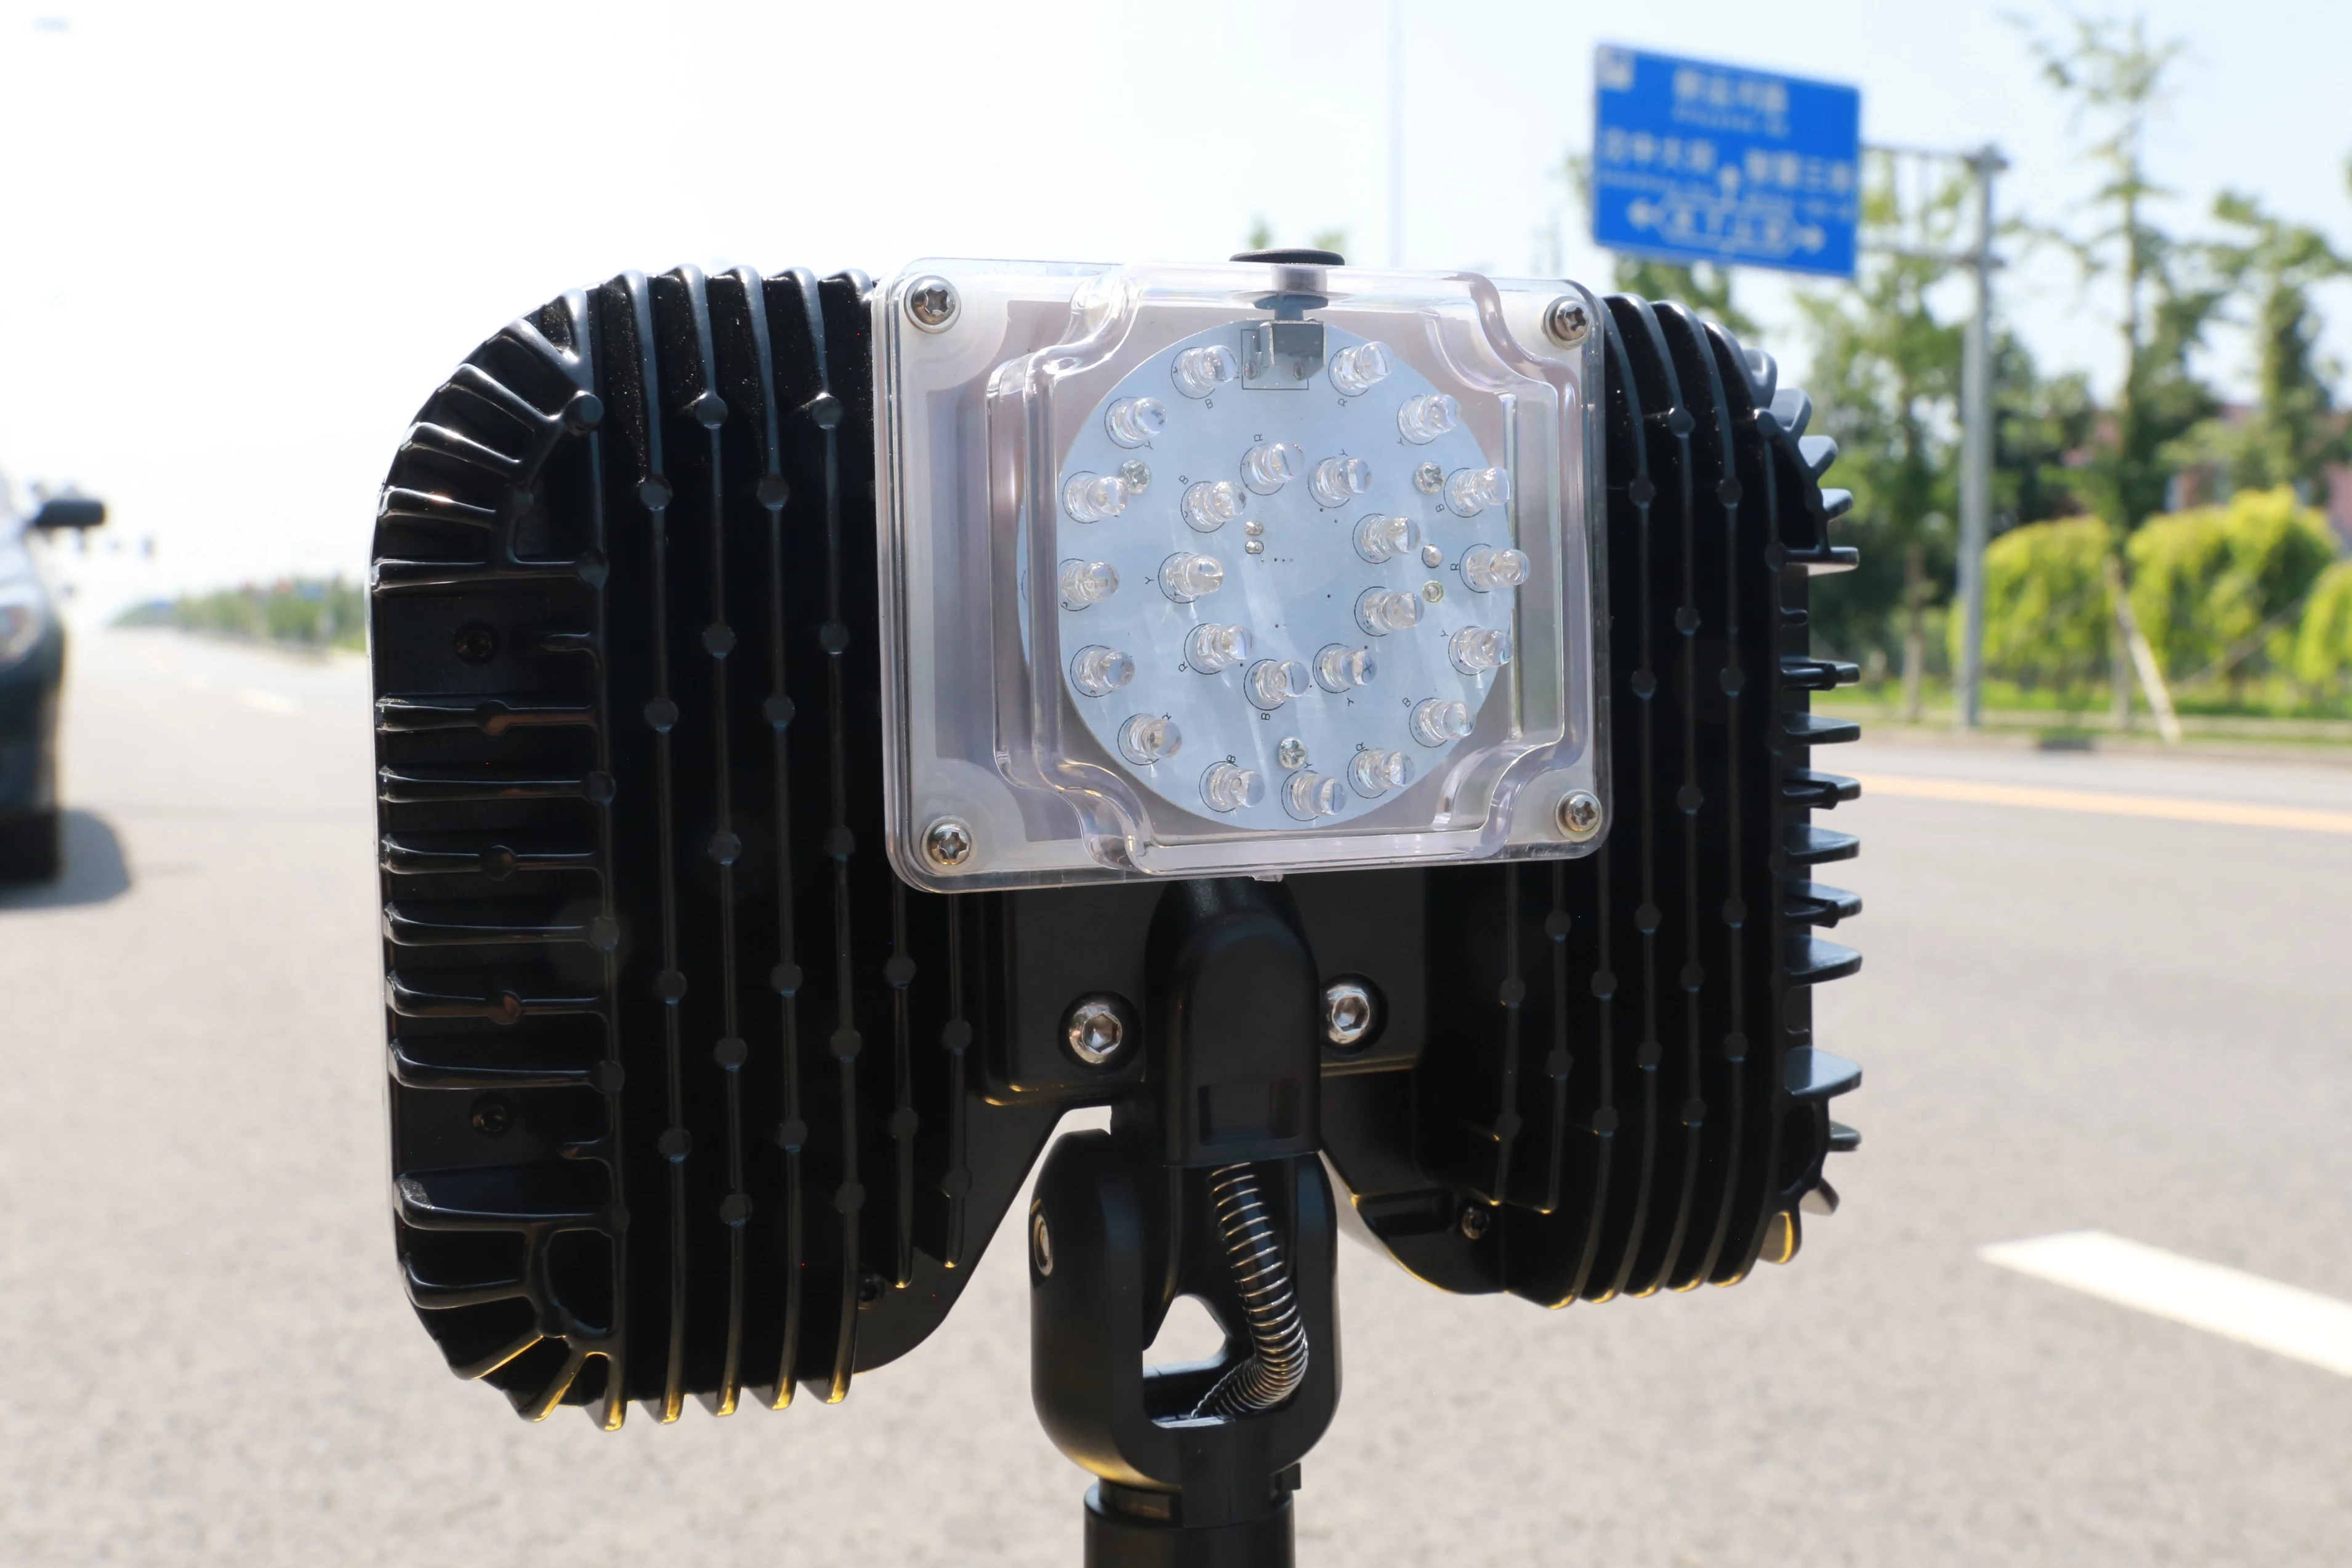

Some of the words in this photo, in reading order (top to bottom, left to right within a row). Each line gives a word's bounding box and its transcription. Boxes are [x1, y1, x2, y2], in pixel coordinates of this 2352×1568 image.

[1205, 398, 1213, 409] B
[1338, 398, 1348, 407] R
[1254, 433, 1263, 442] R
[1396, 438, 1404, 446] Y
[1339, 448, 1348, 456] Y
[1179, 475, 1189, 484] B
[1436, 504, 1444, 512] B
[1178, 661, 1188, 672] R
[1402, 698, 1411, 707] B
[1261, 712, 1271, 720] B
[1356, 742, 1366, 751] R
[1226, 754, 1236, 763] B
